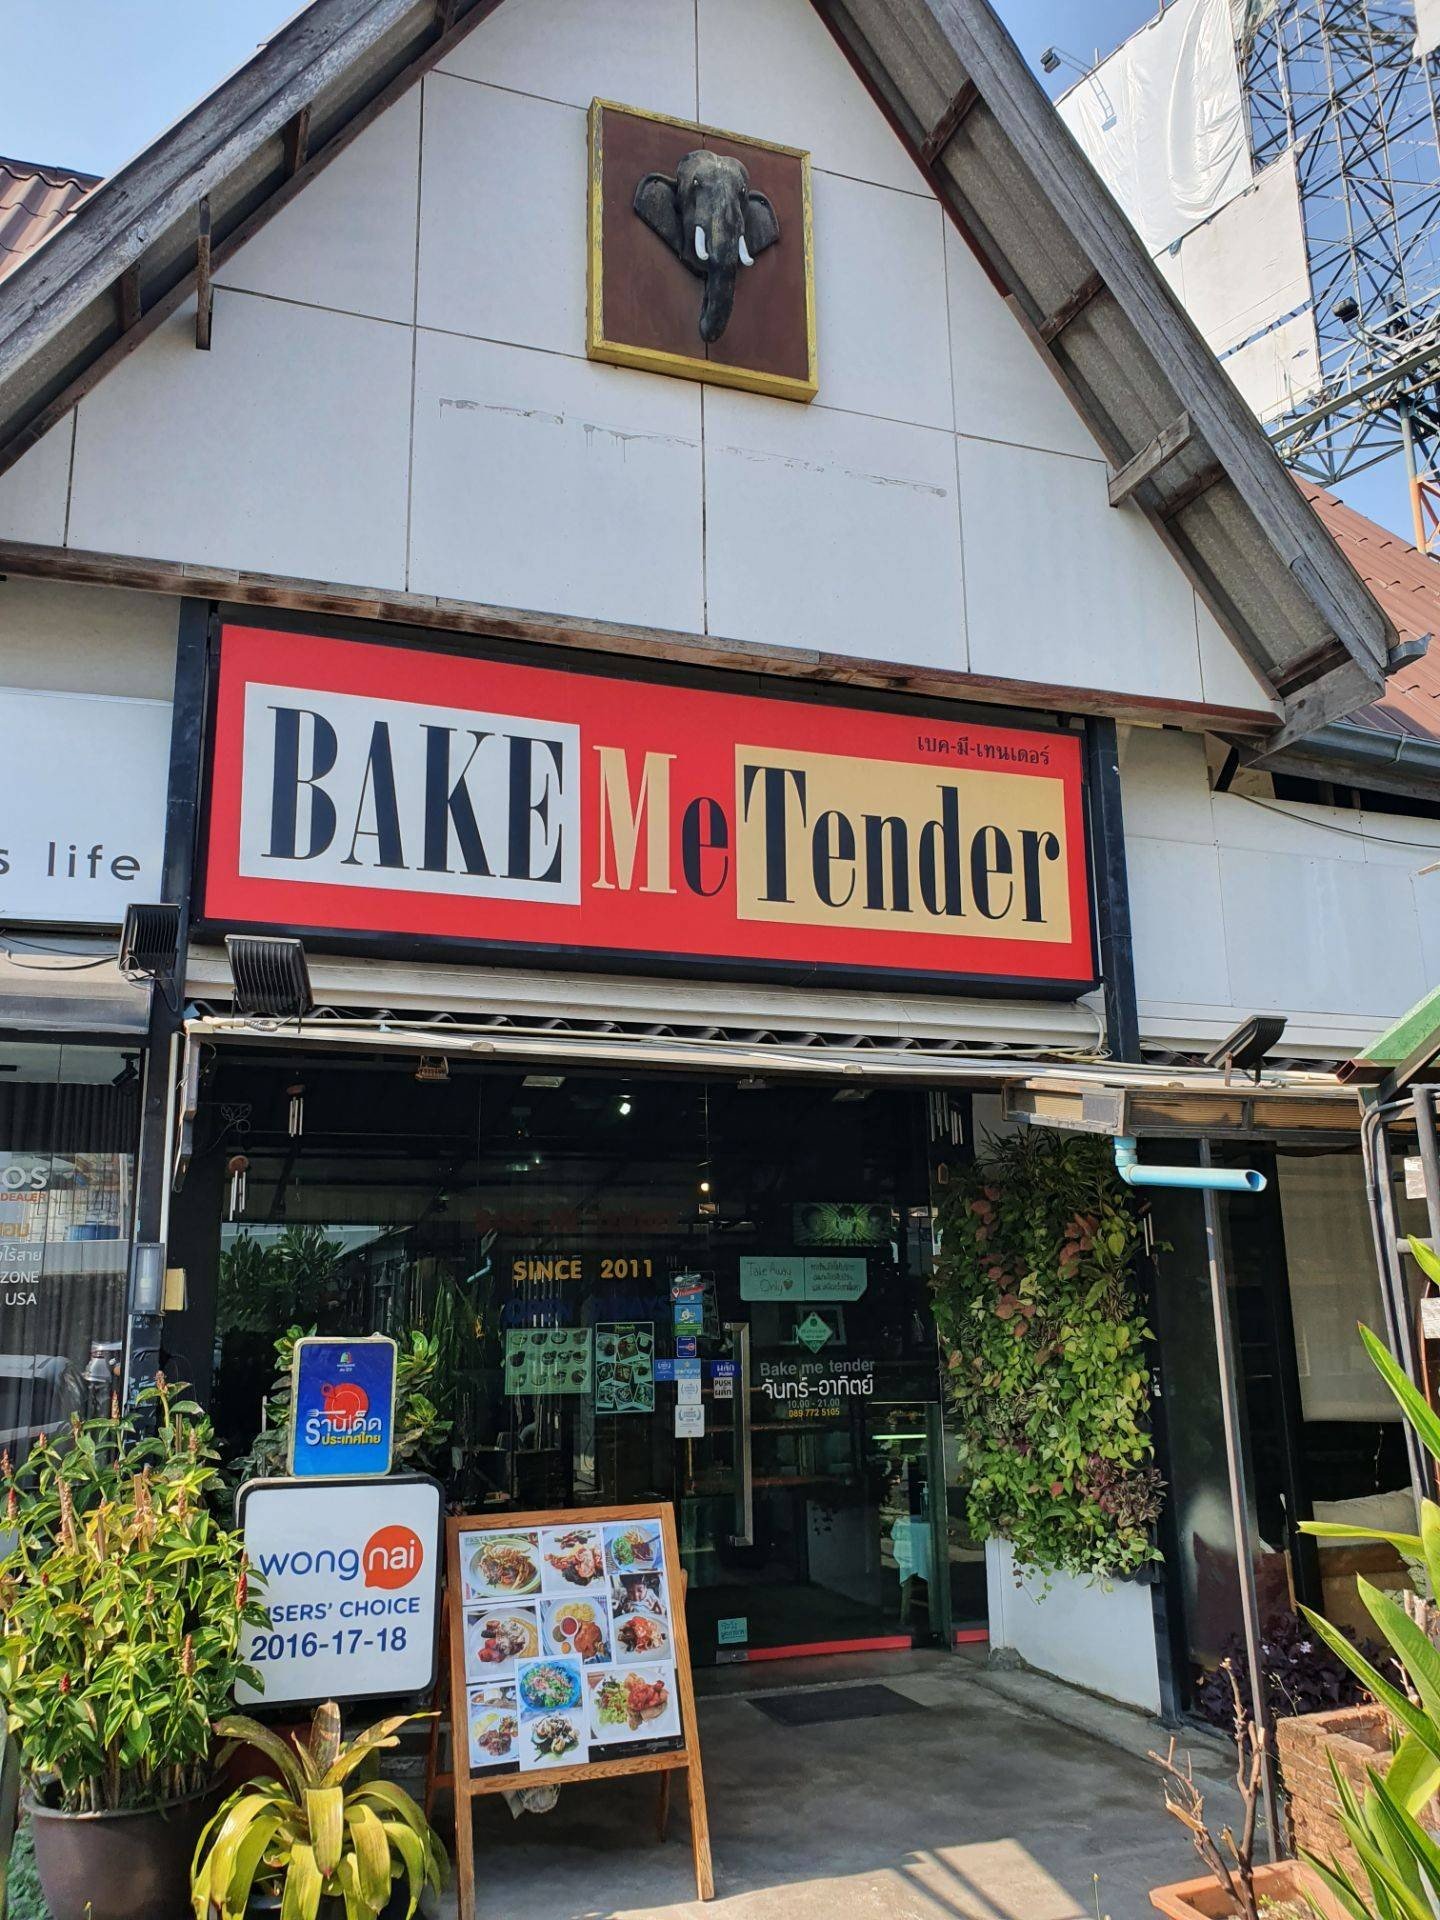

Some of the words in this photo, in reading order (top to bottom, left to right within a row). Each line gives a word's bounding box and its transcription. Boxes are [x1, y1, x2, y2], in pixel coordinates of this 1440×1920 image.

[917, 736, 1050, 765] เบค-มี-เทนเดอร์
[260, 705, 563, 883] BAKE
[591, 745, 729, 897] Me
[743, 764, 1061, 923] Tender
[47, 841, 141, 881] life
[0, 1270, 39, 1284] ZONE
[513, 1259, 582, 1281] SINCE
[600, 1258, 653, 1279] 2011
[5, 1292, 37, 1306] USA
[760, 1361, 797, 1377] Bake
[801, 1362, 824, 1375] me
[829, 1358, 875, 1373] tender
[761, 1374, 874, 1400] จันทร์-อาทิตย์
[321, 1432, 382, 1445] ประเทศไทย
[340, 1597, 421, 1617] CHOICE
[250, 1626, 407, 1661] 2016-17-18
